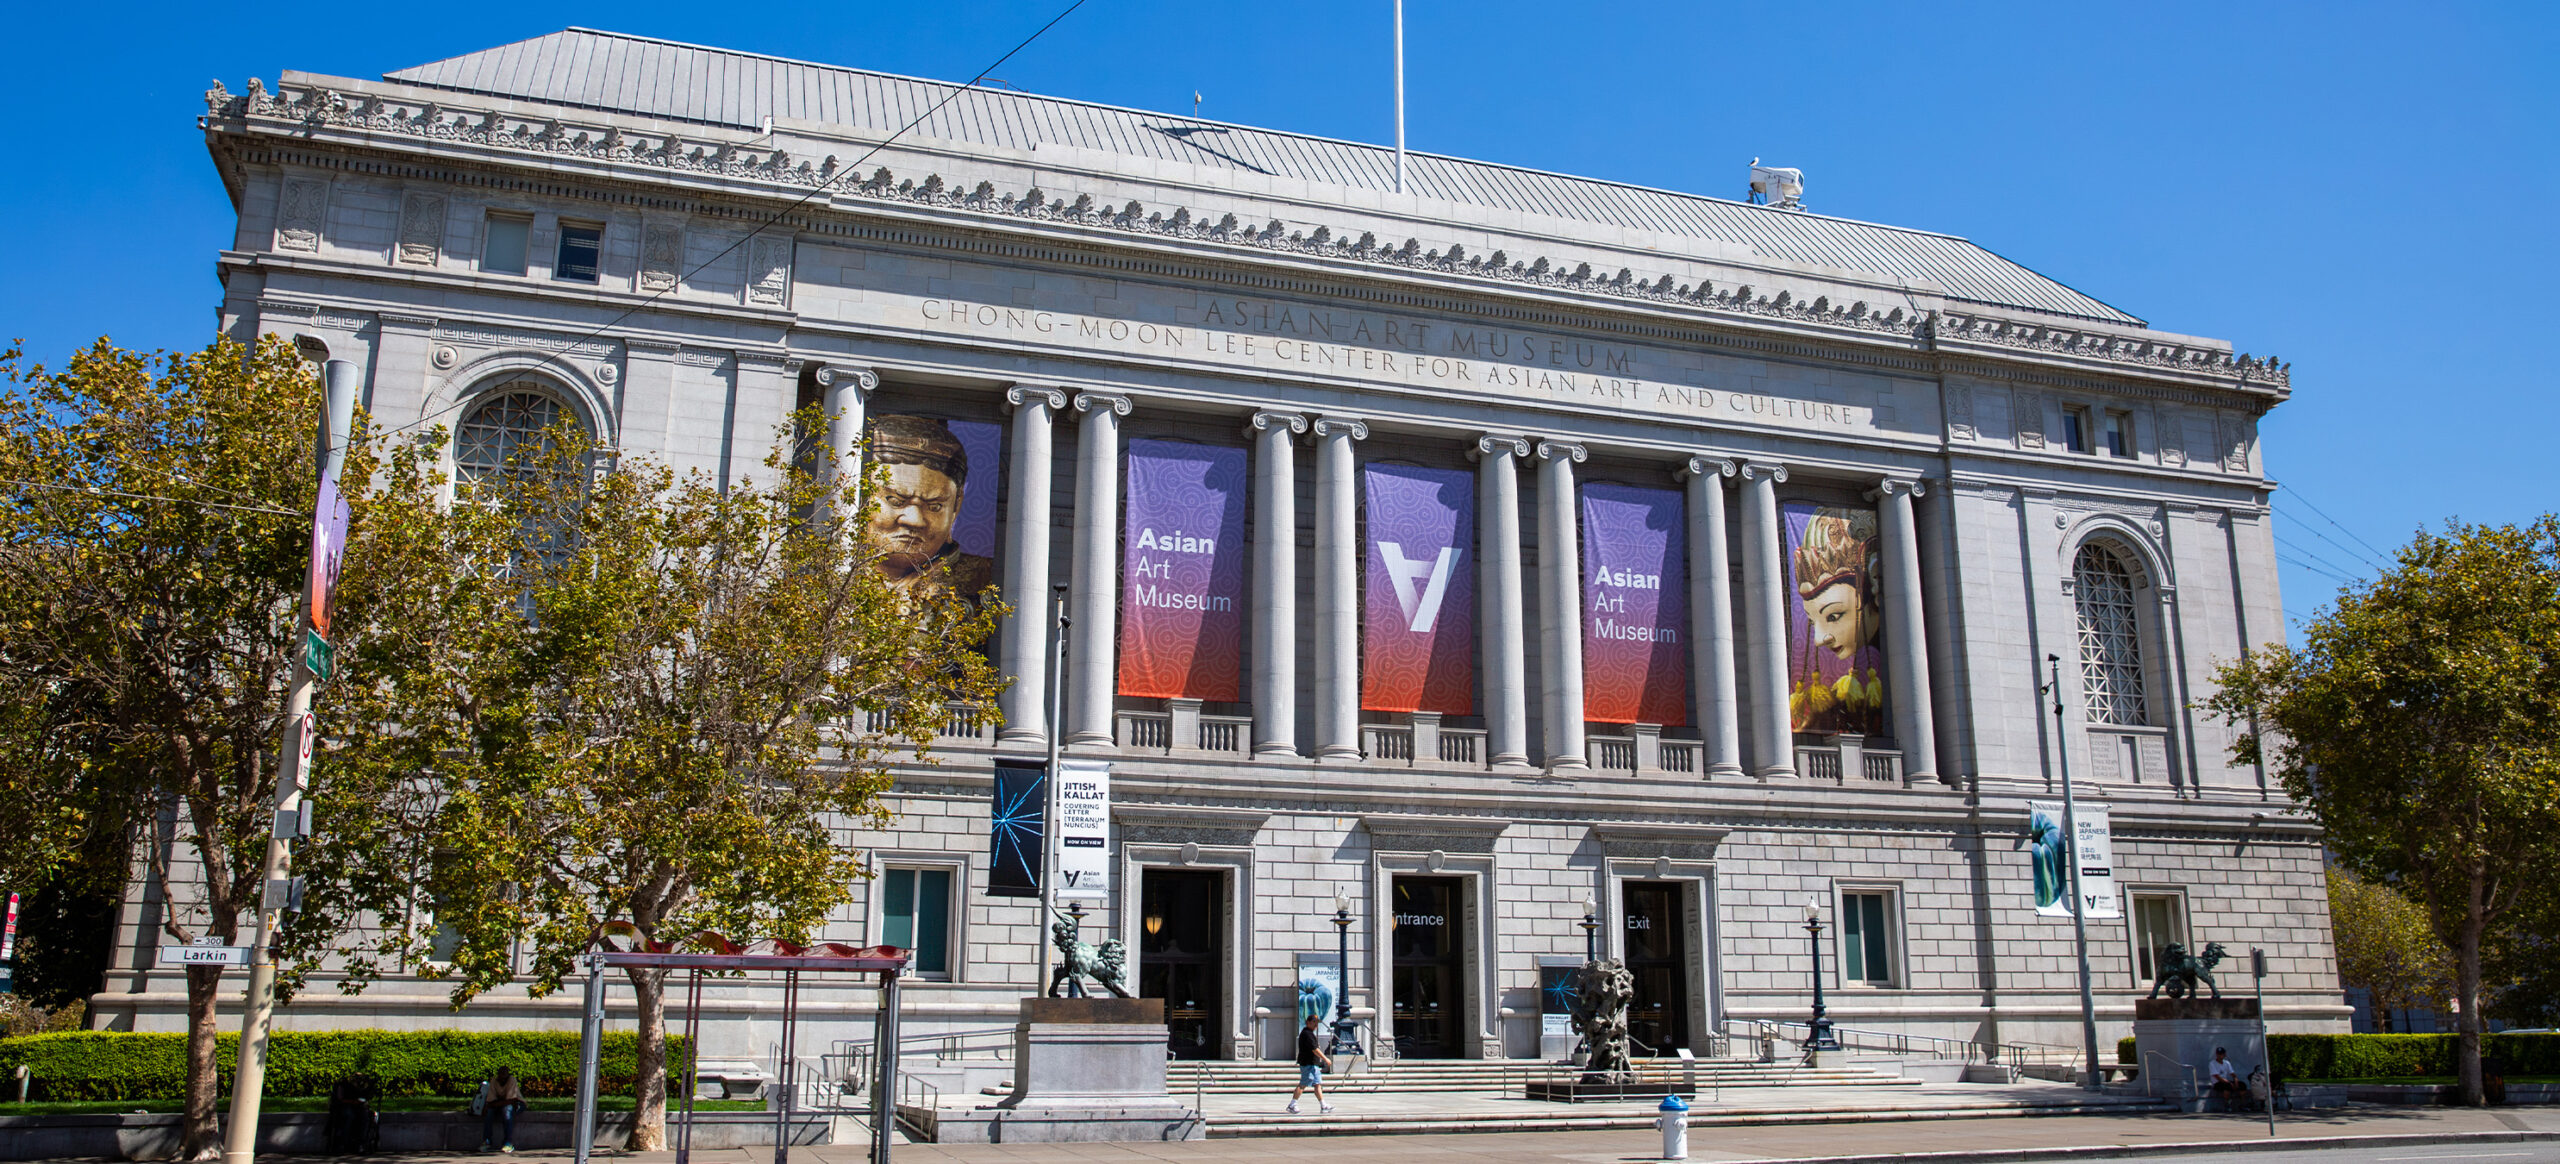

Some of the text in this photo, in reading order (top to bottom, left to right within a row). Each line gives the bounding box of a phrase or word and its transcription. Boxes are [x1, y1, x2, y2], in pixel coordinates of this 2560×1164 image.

[1202, 299, 1633, 374] ASIAN ART MUSEUM
[920, 299, 1853, 426] CHONG-MOON LEE CENTER FOR ASIAN ART AND CULTURE
[1136, 527, 1215, 554] Asian
[1135, 555, 1171, 580] Art
[1594, 565, 1660, 590] Asian
[1135, 583, 1232, 613] Museum
[1594, 591, 1625, 614] Art
[1595, 617, 1676, 644] Museum
[1064, 782, 1096, 791] JITISH
[1064, 791, 1105, 800] KALLAT
[1391, 911, 1444, 926] ntrance
[1627, 914, 1650, 930] Exit
[184, 949, 227, 961] Larkin
